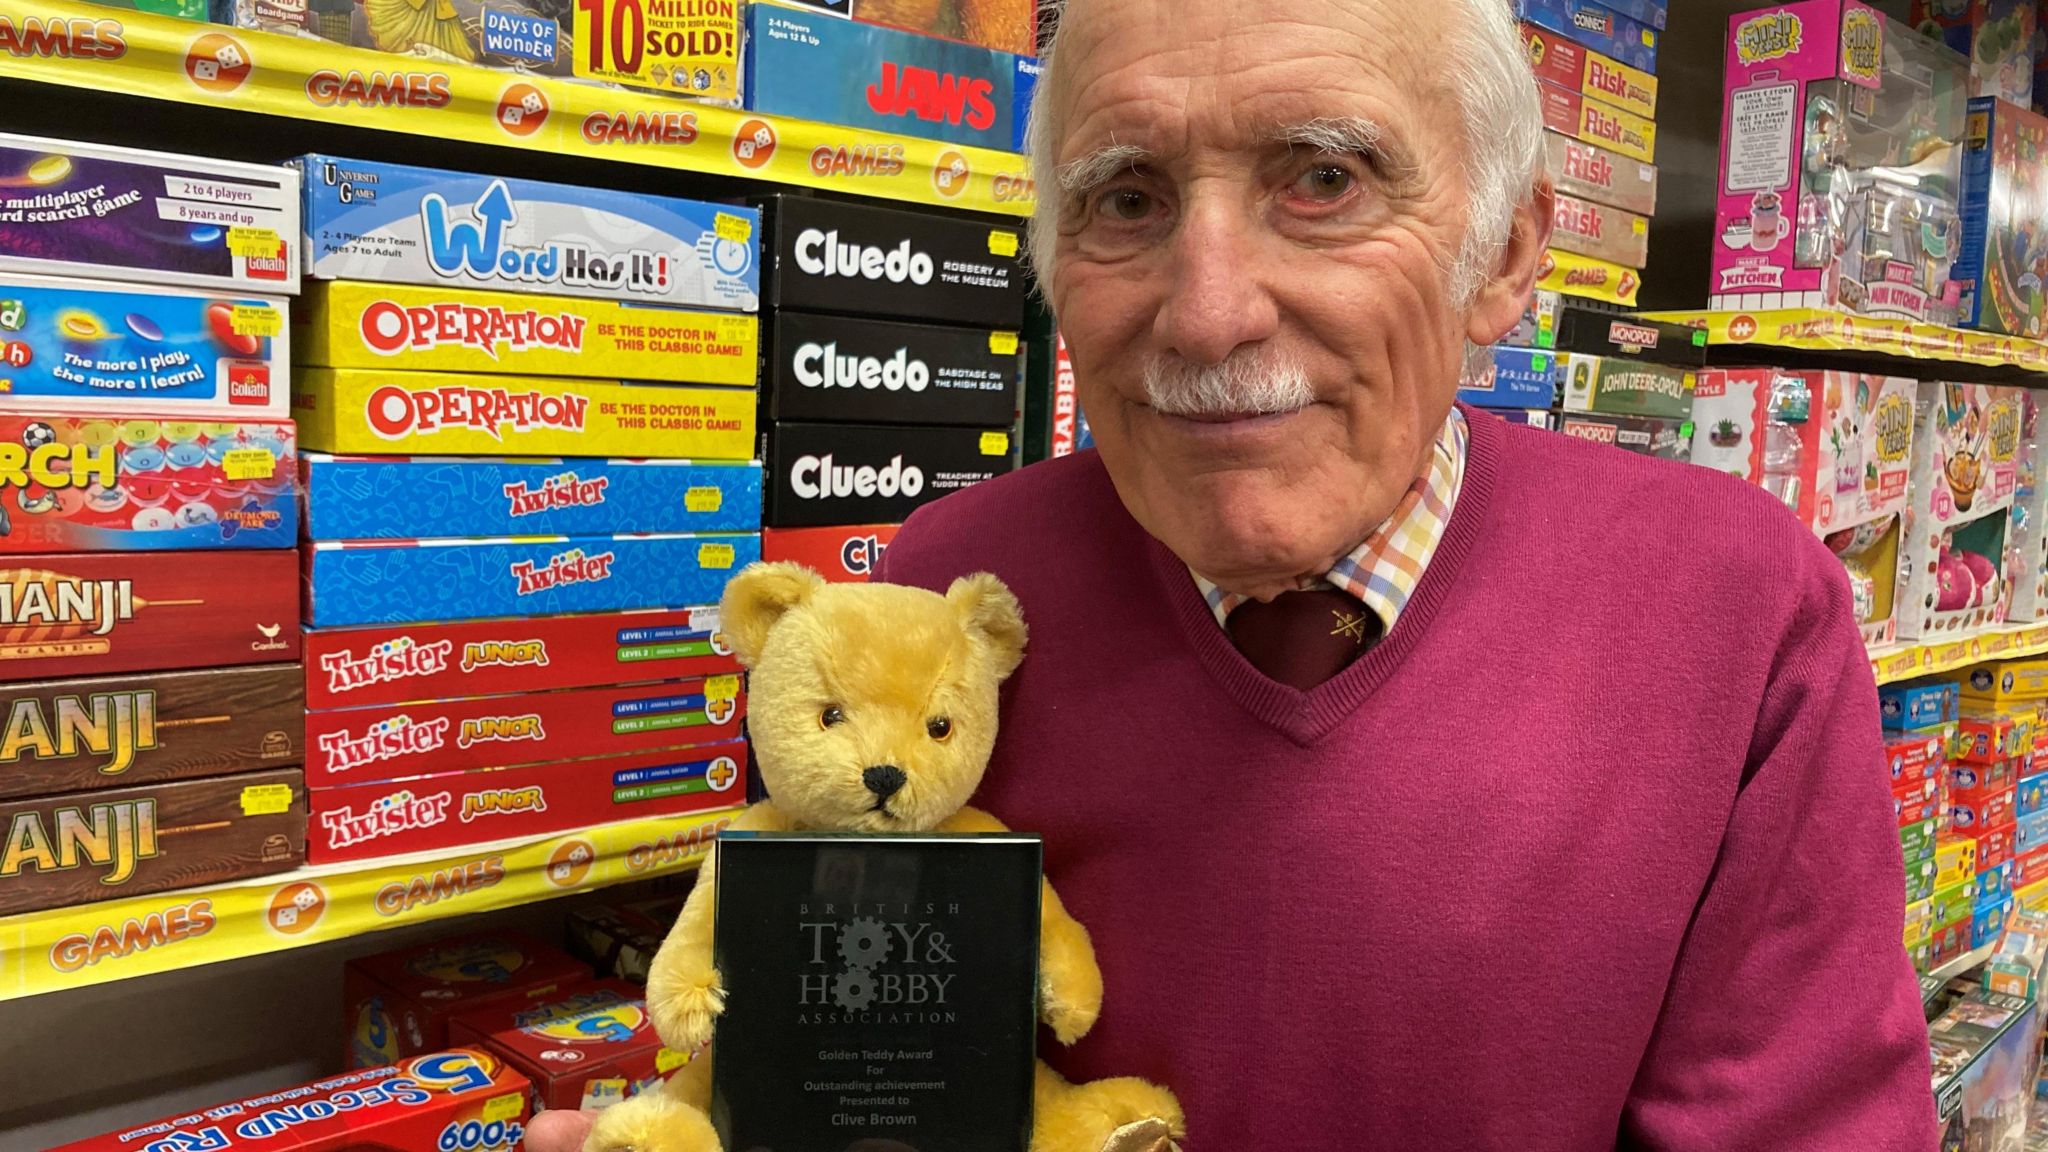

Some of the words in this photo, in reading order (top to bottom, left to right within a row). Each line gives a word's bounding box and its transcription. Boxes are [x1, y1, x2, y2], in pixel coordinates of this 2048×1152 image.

[257, 5, 305, 21] Boardgame
[648, 0, 733, 19] MILLION
[488, 15, 529, 36] DAYS
[533, 22, 553, 39] OF
[648, 17, 673, 28] TICKET
[676, 20, 686, 28] TO
[687, 19, 705, 28] RIDE
[707, 20, 733, 30] GAMES
[1573, 13, 1606, 33] CONNECT
[1744, 17, 1793, 46] MINI
[488, 33, 553, 59] WONDER
[579, 0, 645, 74] 10
[647, 30, 733, 57] SOLD!
[768, 28, 787, 39] Ages
[790, 32, 799, 41] 12
[808, 36, 820, 46] Up
[1750, 38, 1790, 57] VERSE
[1847, 23, 1877, 49] MINI
[304, 71, 452, 108] GAMES
[1588, 60, 1628, 99] Risk
[866, 62, 996, 131] JAWS
[581, 111, 699, 145] GAMES
[1584, 106, 1622, 144] Risk
[809, 145, 905, 178] GAMES
[1563, 142, 1613, 189] Risk
[324, 164, 379, 186] UNIVERSITY
[6, 184, 106, 210] multiplayer
[184, 183, 190, 193] 2
[192, 184, 204, 195] to
[206, 186, 213, 196] 4
[215, 186, 253, 201] players
[340, 182, 375, 203] GAMES
[27, 204, 91, 223] search
[92, 189, 143, 217] game
[179, 206, 186, 216] 8
[188, 208, 217, 222] years
[218, 211, 238, 223] and
[241, 214, 255, 226] up
[323, 231, 329, 239] 2
[344, 233, 375, 244] Players
[389, 237, 416, 247] Teams
[424, 181, 558, 276] Word
[565, 247, 625, 283] Has
[632, 254, 667, 287] It!
[323, 244, 348, 254] Ages
[361, 247, 372, 255] to
[374, 248, 402, 257] Adult
[794, 228, 934, 286] Cluedo
[941, 273, 960, 286] THE
[962, 275, 1009, 289] MUSEUM
[943, 261, 994, 277] ROBBERY
[995, 266, 1008, 277] AT
[1726, 272, 1778, 285] KITCHEN
[1871, 287, 1889, 302] MINI
[1890, 289, 1921, 313] KITCHEN
[362, 301, 586, 361] OPERATION
[598, 324, 615, 336] BE
[618, 325, 644, 338] THE
[647, 326, 700, 340] DOCTOR
[702, 328, 717, 341] IN
[1610, 327, 1656, 346] MONOPOLY
[614, 338, 645, 352] THIS
[649, 339, 702, 354] CLASSIC
[706, 342, 743, 357] GAME!
[64, 352, 92, 369] The
[97, 359, 137, 372] more
[141, 358, 147, 370] I
[150, 350, 191, 373] play,
[793, 342, 929, 392] Cluedo
[938, 367, 987, 380] SABOTAGE
[988, 371, 1002, 380] ON
[52, 365, 85, 384] the
[89, 376, 136, 391] more
[140, 376, 147, 389] I
[151, 364, 206, 390] learn!
[230, 380, 268, 398] Goliath
[935, 379, 952, 389] THE
[953, 379, 977, 390] HIGH
[979, 380, 1004, 391] SEAS
[1602, 372, 1629, 393] JOHN
[1628, 373, 1684, 400] DEERE-OPOLY
[368, 386, 588, 442] OPERATION
[600, 403, 618, 416] BE
[620, 404, 645, 417] THE
[649, 404, 699, 417] DOCTOR
[702, 405, 716, 418] IN
[1879, 403, 1909, 437] MINI
[616, 416, 647, 429] THIS
[650, 417, 702, 430] CLASSIC
[707, 418, 742, 432] GAME!
[790, 455, 924, 500] Cluedo
[932, 480, 959, 488] TUDOR
[936, 472, 981, 480] TREACHERY
[506, 473, 607, 517] Twister
[513, 549, 614, 595] Twister
[321, 637, 452, 693] Twister
[461, 640, 549, 671] JUNIOR
[621, 650, 641, 658] LEVEL
[617, 704, 638, 713] LEVEL
[458, 715, 545, 748] JUNIOR
[617, 722, 638, 730] LEVEL
[320, 715, 450, 774] Twister
[618, 774, 639, 782] LEVEL
[461, 787, 546, 820] JUNIOR
[618, 791, 638, 799] LEVEL
[323, 791, 452, 850] Twister
[374, 855, 506, 917] GAMES
[800, 903, 960, 915] BRITISH
[50, 898, 216, 973] GAMES
[798, 967, 957, 1013] HOBBY
[798, 1012, 956, 1025] ASSOCIATION
[818, 1050, 858, 1061] Golden
[861, 1050, 894, 1063] Teddy
[896, 1050, 933, 1060] Award
[410, 1053, 494, 1095] 5
[866, 1065, 884, 1075] For
[803, 1081, 872, 1093] Outstanding
[874, 1079, 945, 1091] achievement
[237, 1077, 432, 1139] SECOND
[839, 1096, 895, 1106] Presented
[898, 1097, 910, 1106] to
[831, 1113, 866, 1126] Clive
[869, 1113, 917, 1126] Brown
[438, 1119, 525, 1152] 600+
